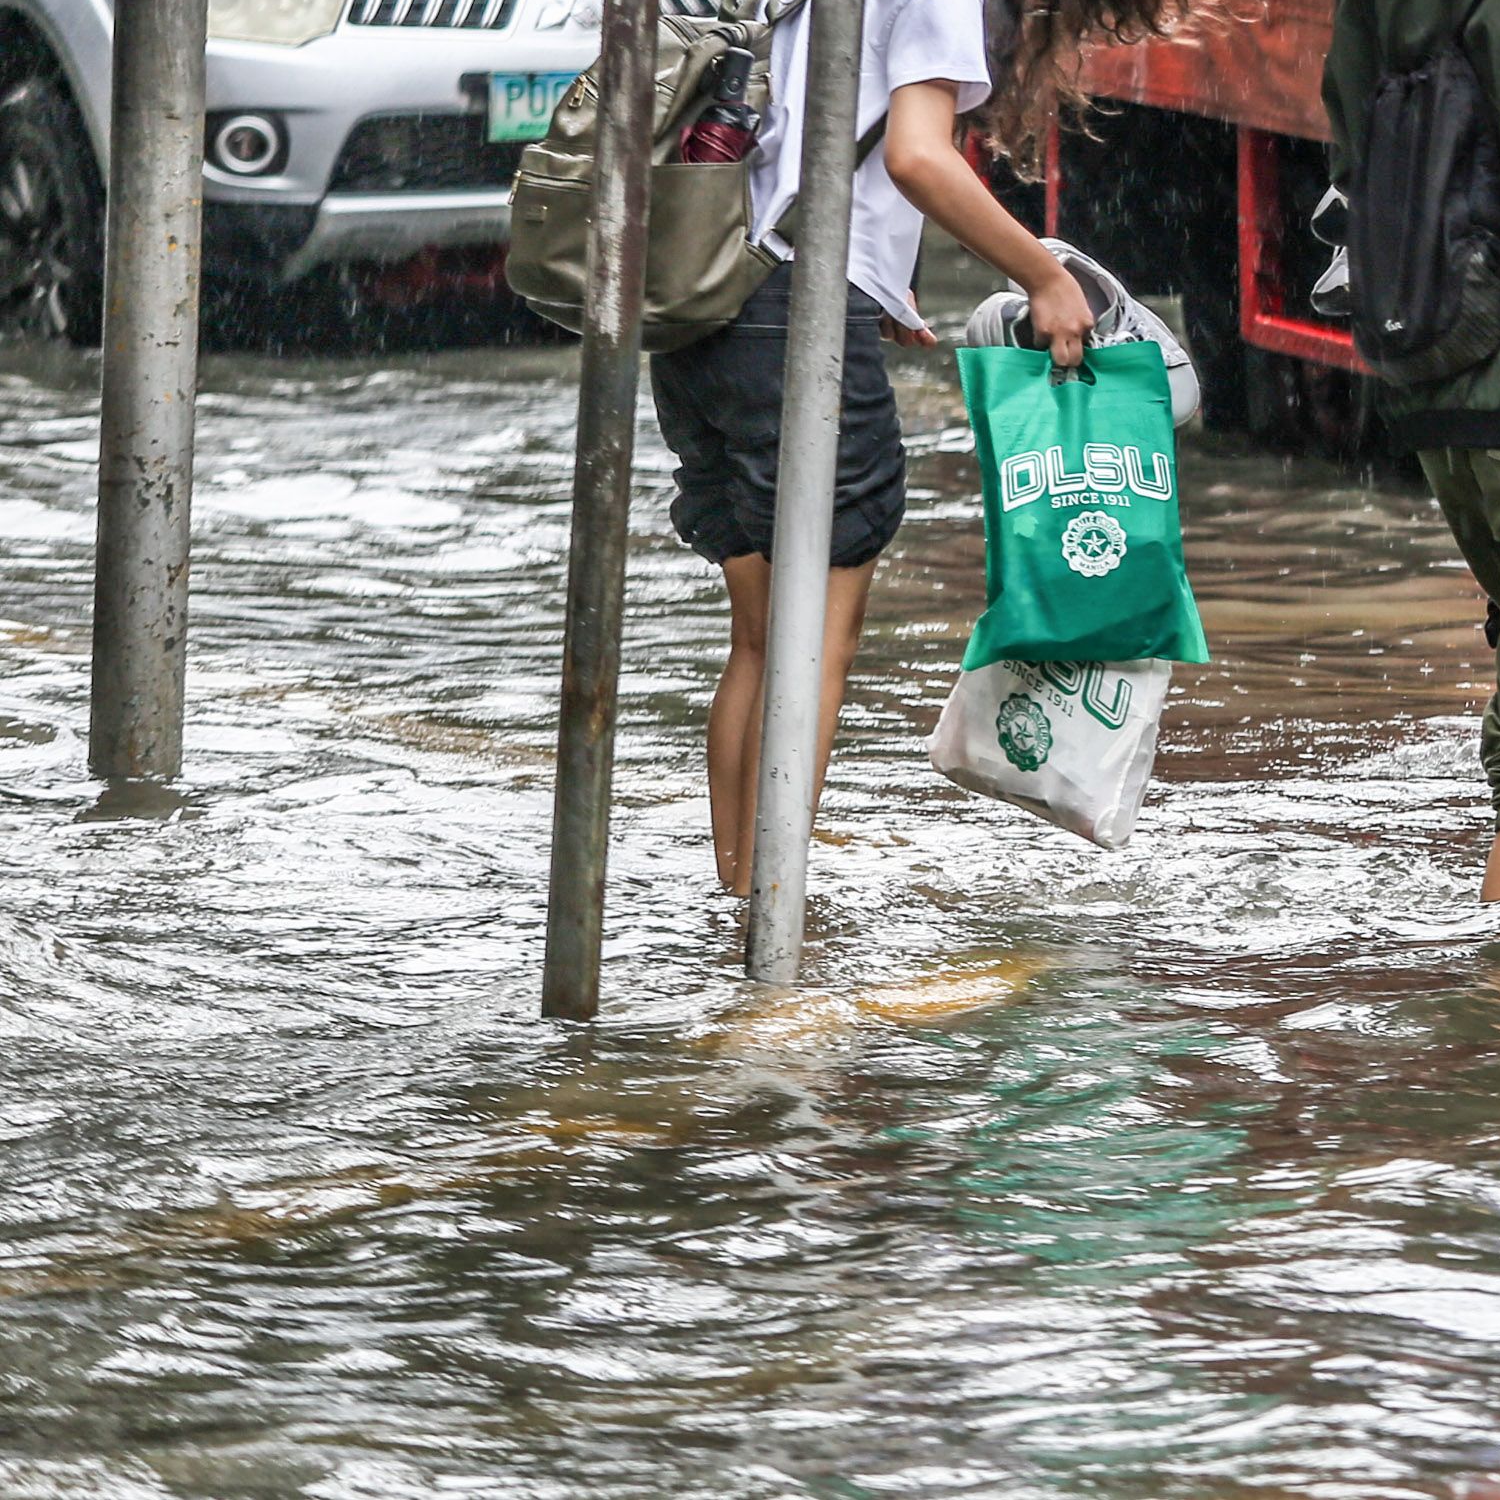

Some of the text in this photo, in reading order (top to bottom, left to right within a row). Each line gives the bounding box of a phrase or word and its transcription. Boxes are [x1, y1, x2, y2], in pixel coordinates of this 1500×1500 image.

[1000, 442, 1173, 513] DLSU
[1050, 492, 1132, 509] SINCE 1911
[1003, 658, 1076, 719] SINCE 1911
